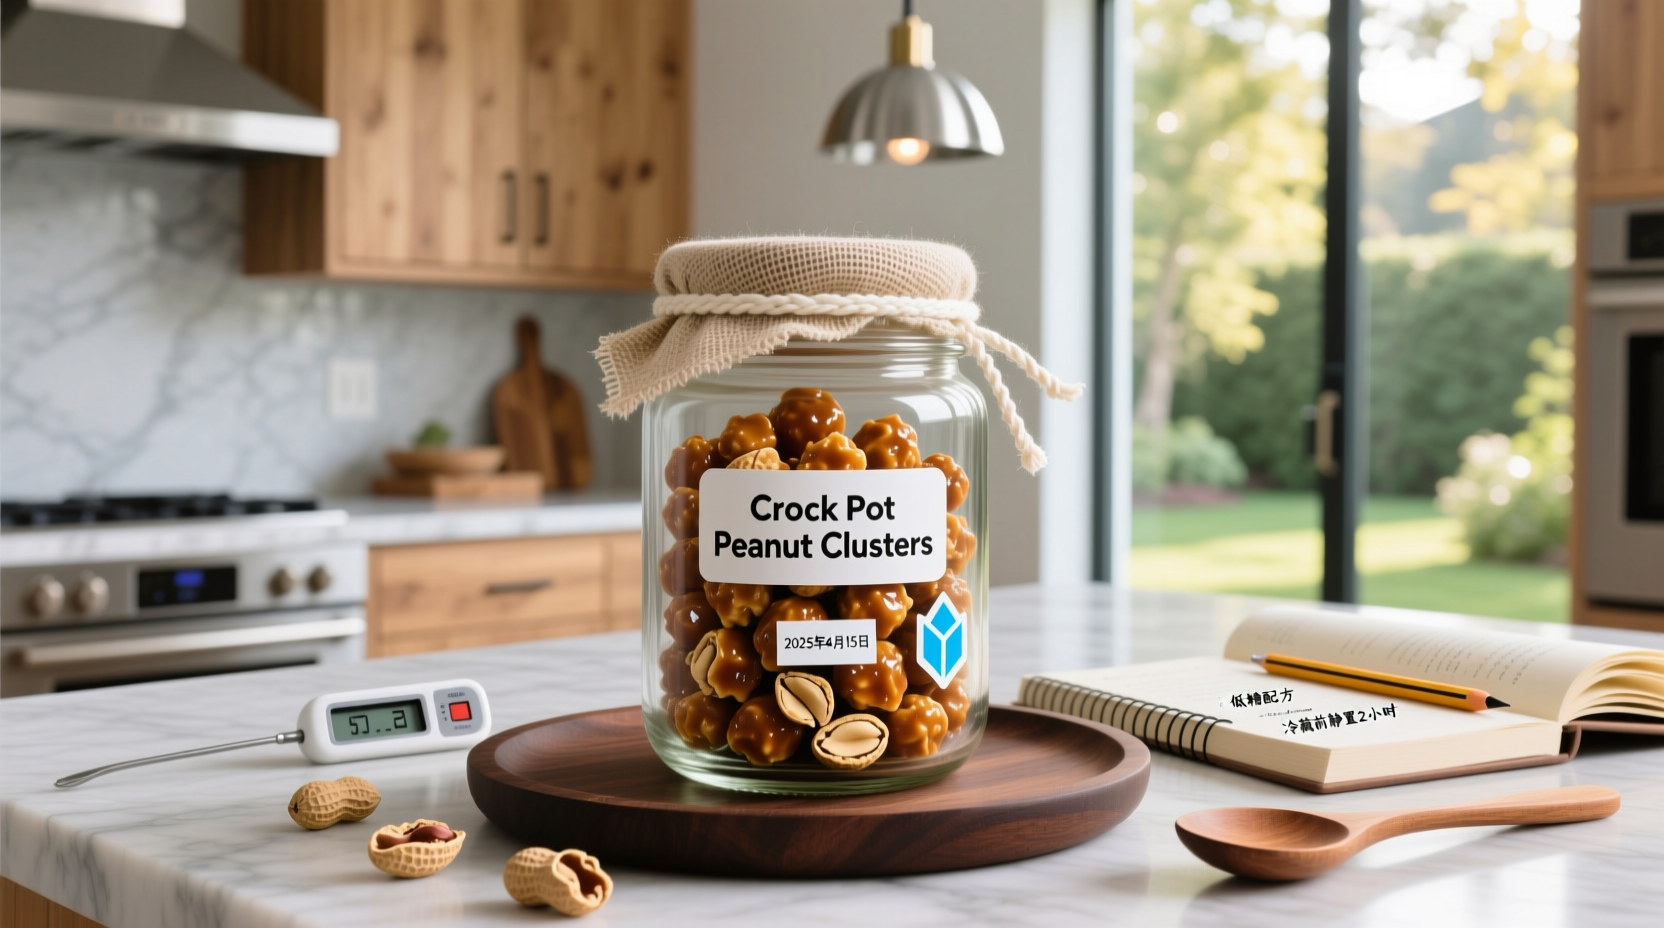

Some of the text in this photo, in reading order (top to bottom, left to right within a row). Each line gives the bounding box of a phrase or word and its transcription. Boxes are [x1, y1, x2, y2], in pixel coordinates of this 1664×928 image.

[750, 493, 896, 522] Crock Pot
[714, 530, 933, 559] Peanut Clusters
[784, 634, 869, 650] 2025年4月15日
